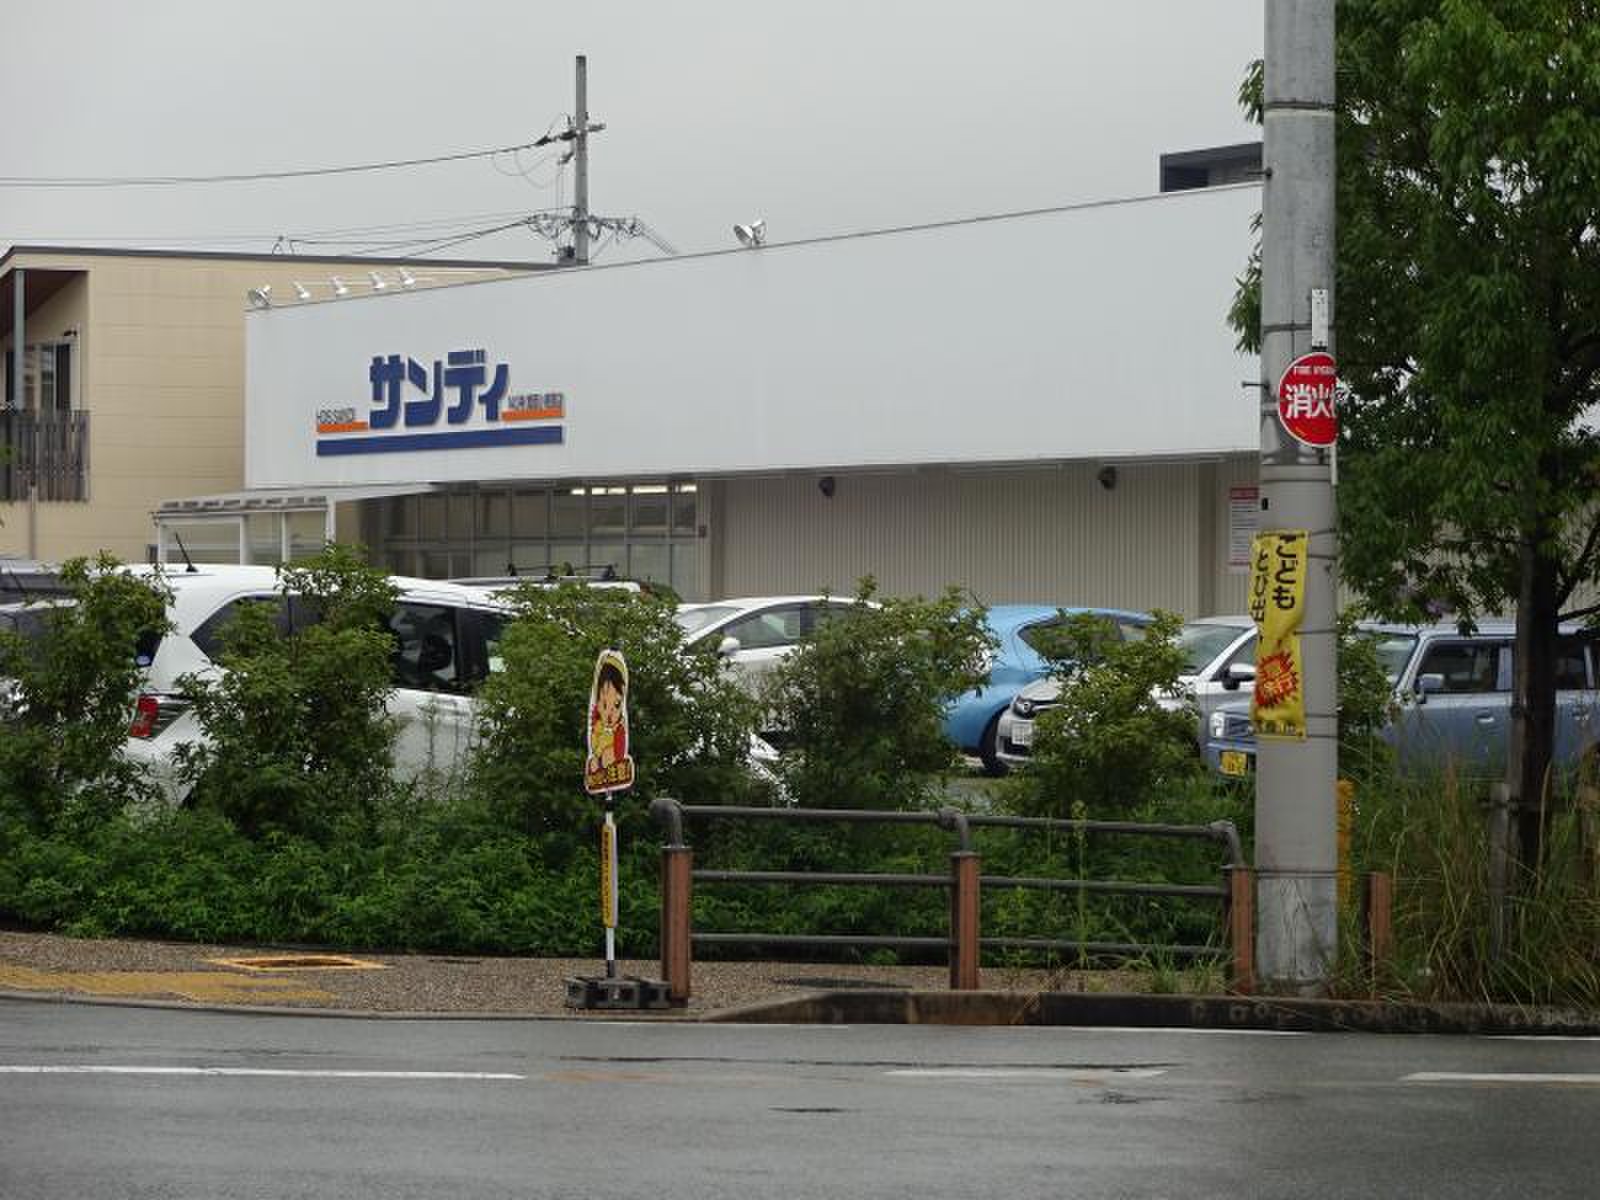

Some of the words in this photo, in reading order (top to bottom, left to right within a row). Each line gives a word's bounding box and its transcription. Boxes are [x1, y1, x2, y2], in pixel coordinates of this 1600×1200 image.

[369, 349, 509, 429] サンディ
[1273, 533, 1298, 610] こども
